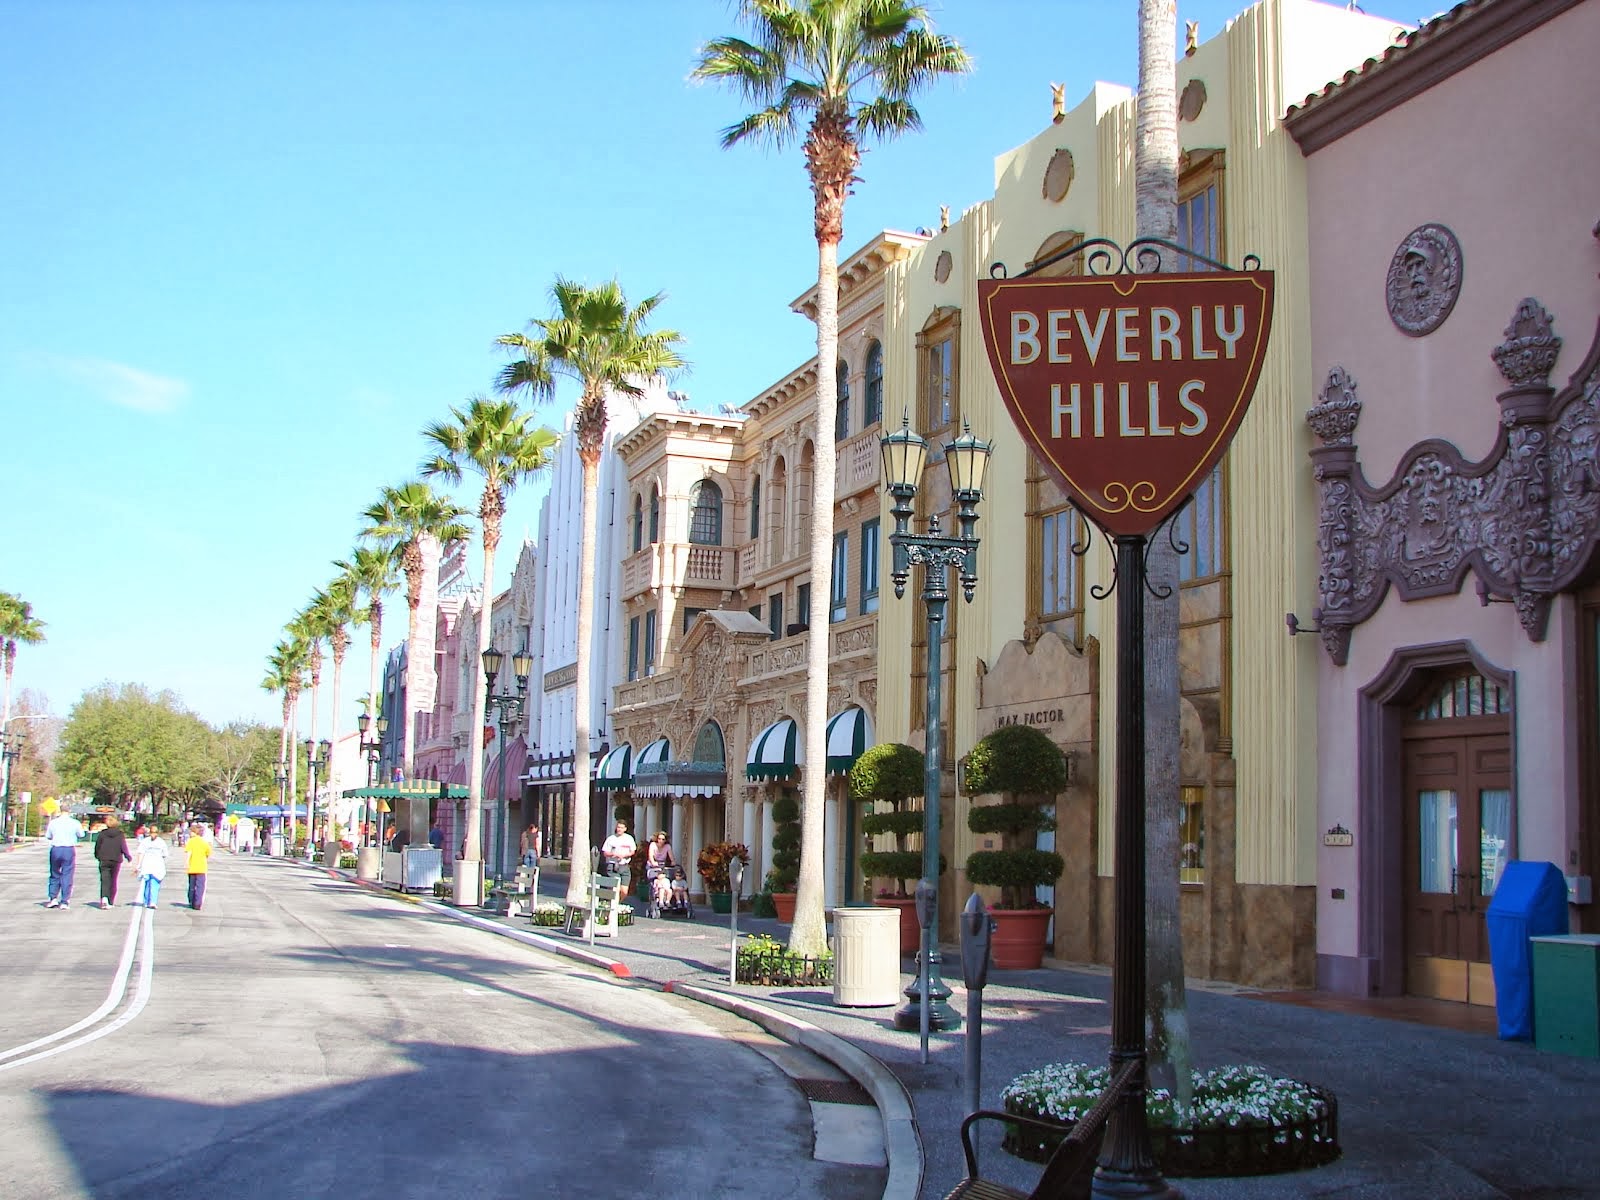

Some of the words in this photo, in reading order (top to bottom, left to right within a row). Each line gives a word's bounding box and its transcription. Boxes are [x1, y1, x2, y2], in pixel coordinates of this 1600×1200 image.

[1011, 305, 1245, 366] BEVERLY
[1051, 379, 1208, 438] HILLS
[998, 714, 1019, 728] MAX
[1024, 710, 1064, 725] FACTOR
